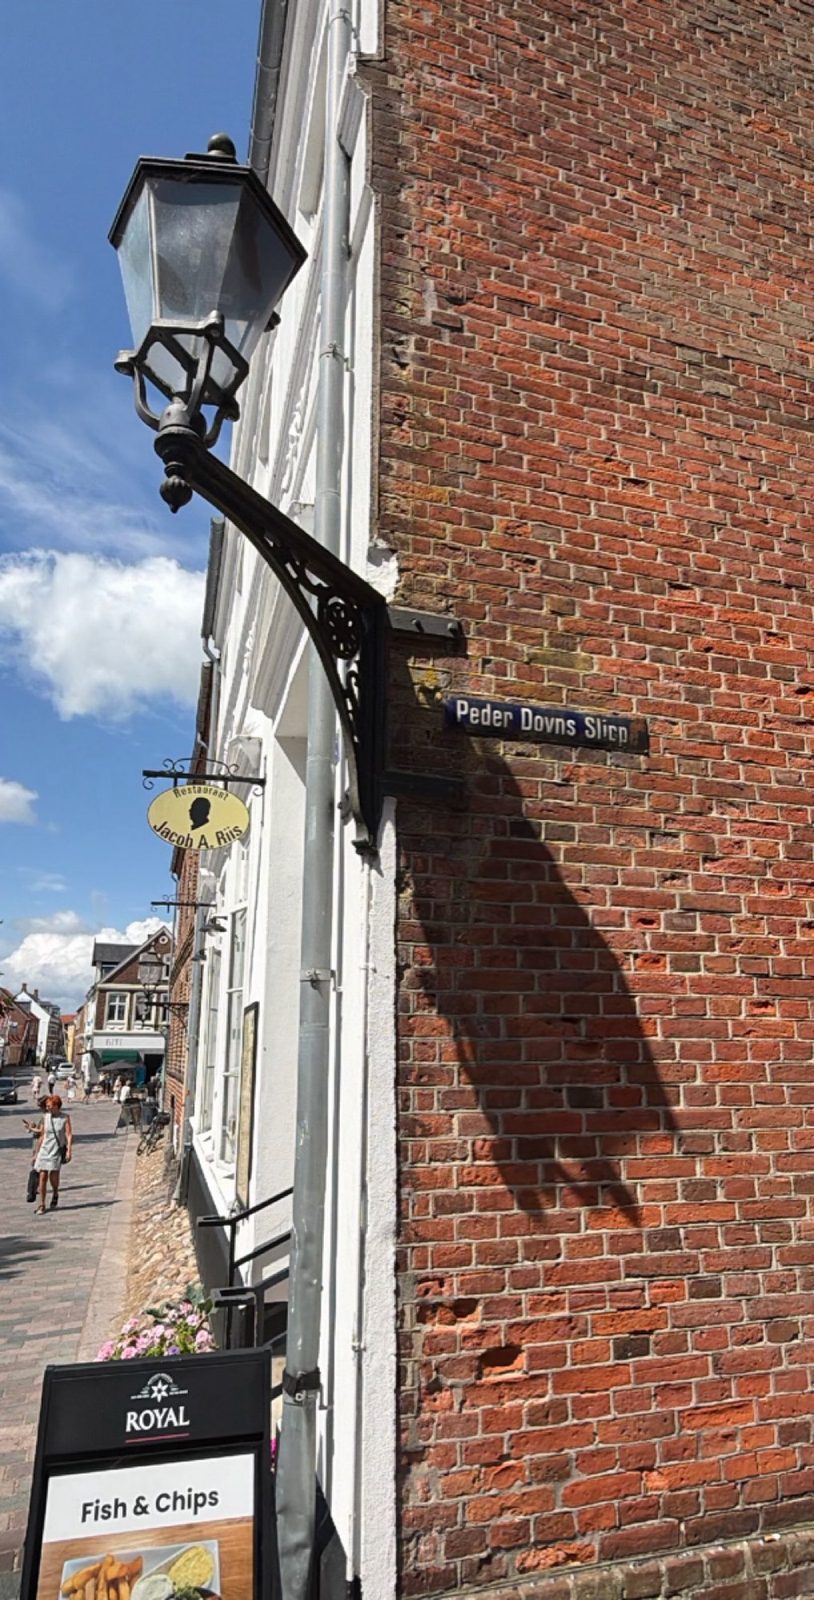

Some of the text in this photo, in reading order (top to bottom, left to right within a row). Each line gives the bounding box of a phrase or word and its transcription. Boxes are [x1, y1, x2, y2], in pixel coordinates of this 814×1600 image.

[456, 700, 513, 728] Peder
[520, 707, 577, 737] Dovns
[173, 786, 229, 800] Restaurant
[197, 834, 214, 849] A.
[215, 826, 243, 846] Riis
[125, 1406, 190, 1432] ROYAL
[80, 1487, 219, 1523] Fish & Chips
